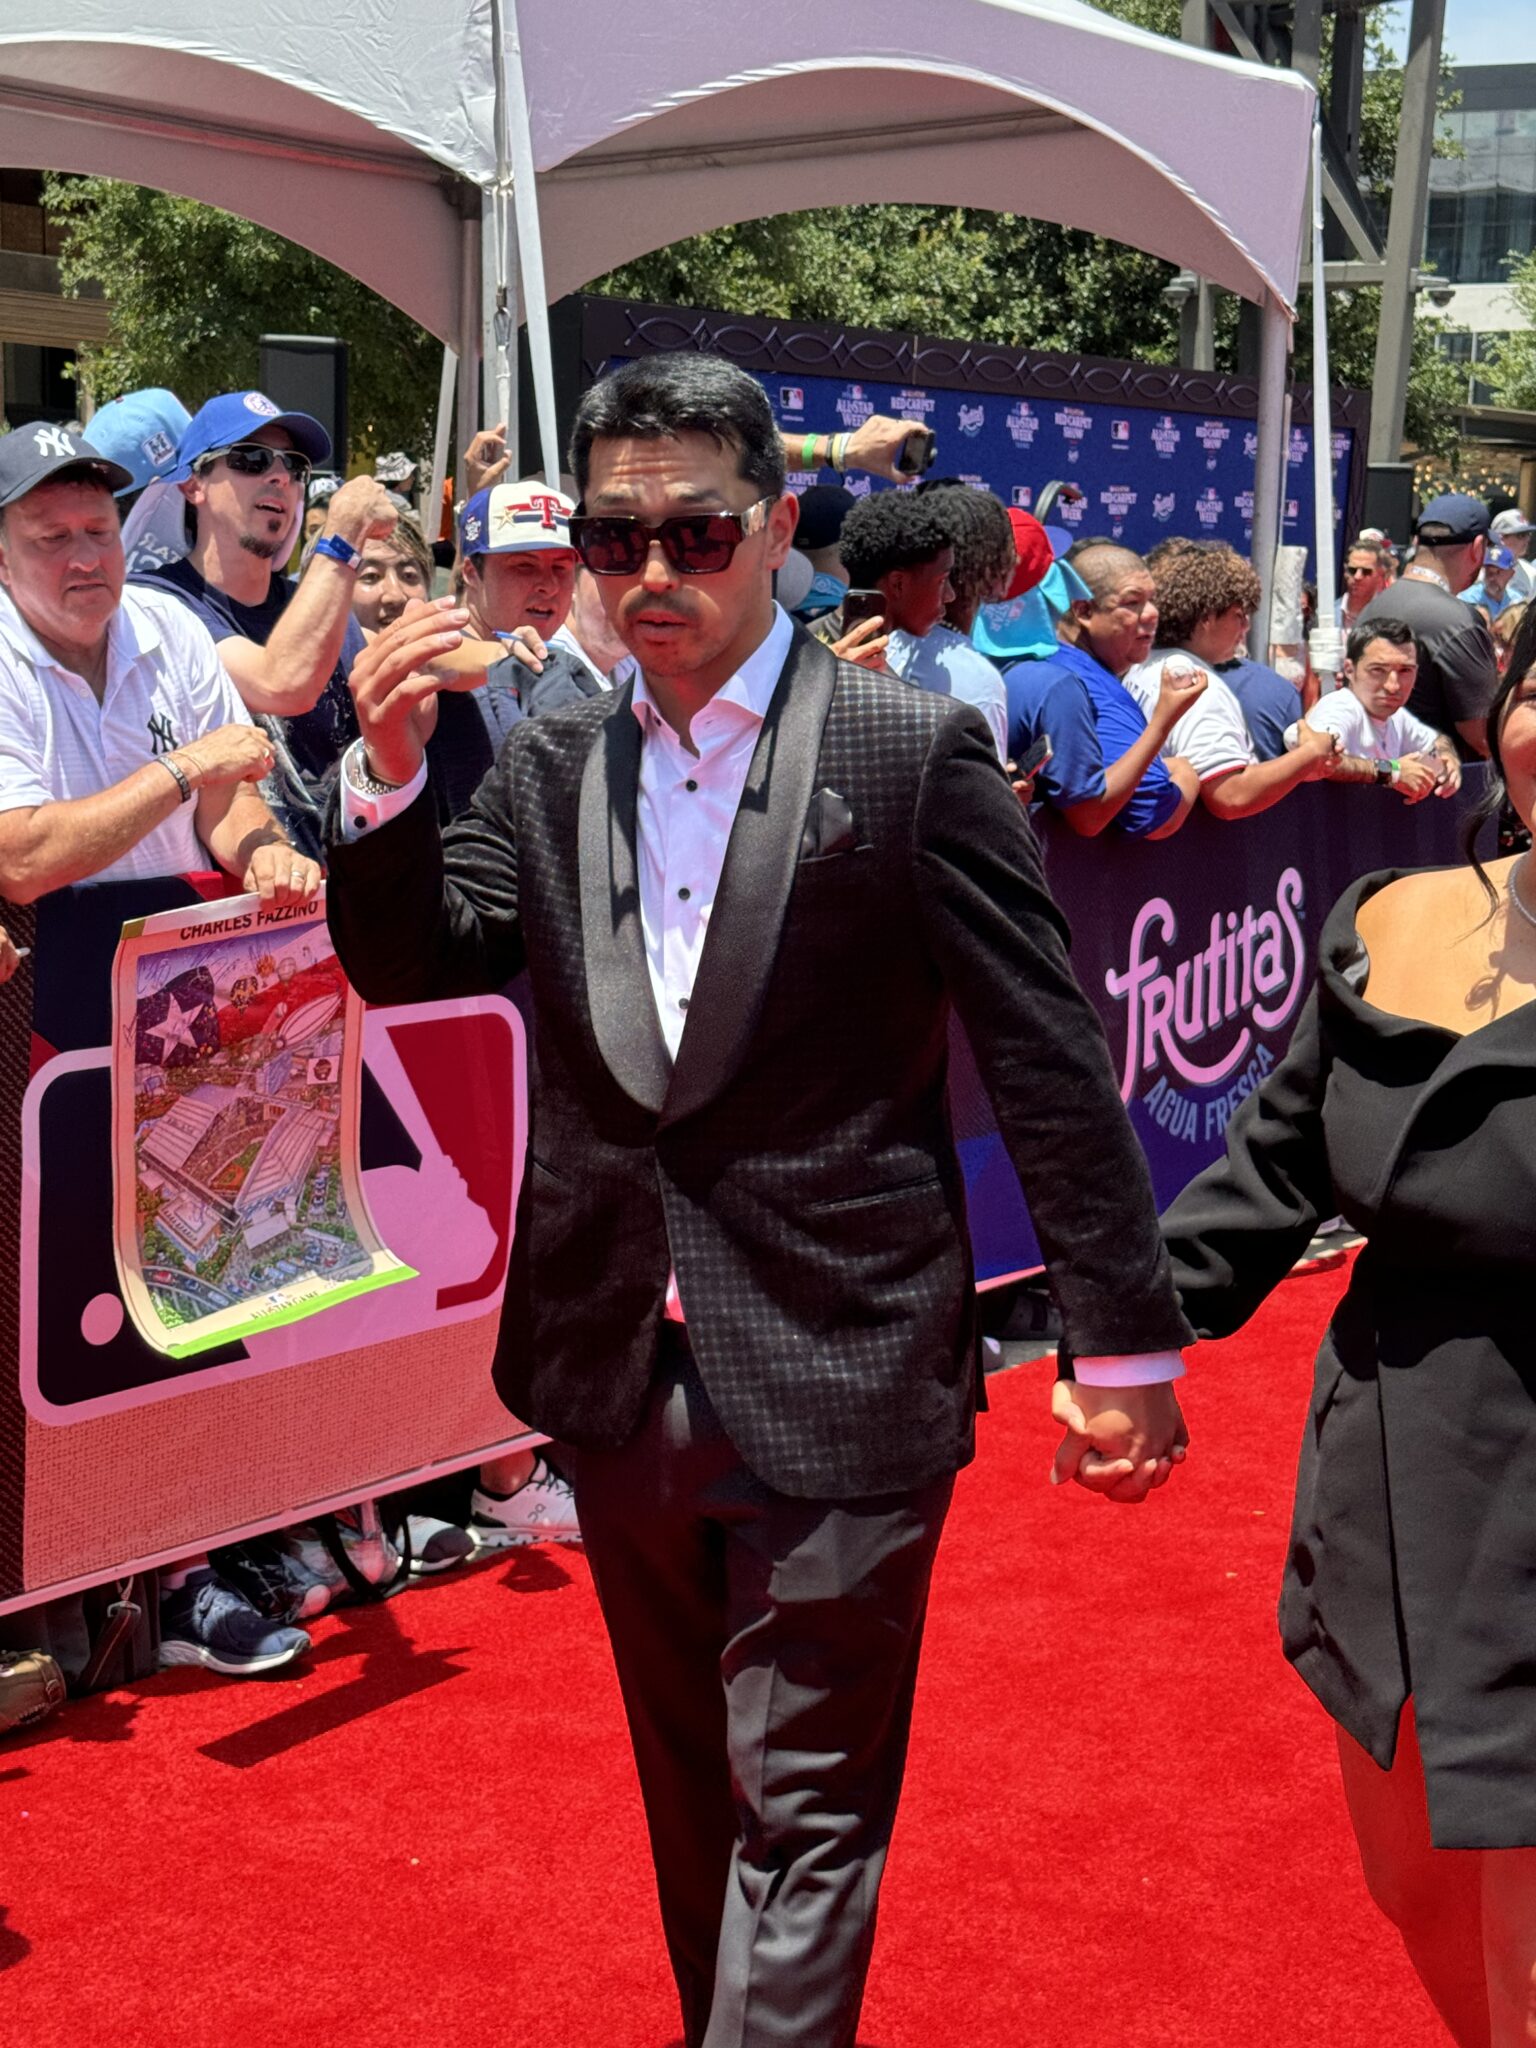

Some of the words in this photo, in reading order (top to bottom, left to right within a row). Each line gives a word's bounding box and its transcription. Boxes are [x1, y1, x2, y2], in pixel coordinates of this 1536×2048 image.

[529, 494, 562, 531] T
[147, 712, 179, 755] NY
[180, 912, 253, 941] CHARLES
[1142, 1074, 1197, 1144] AGUA
[1205, 1042, 1275, 1142] FRESCA
